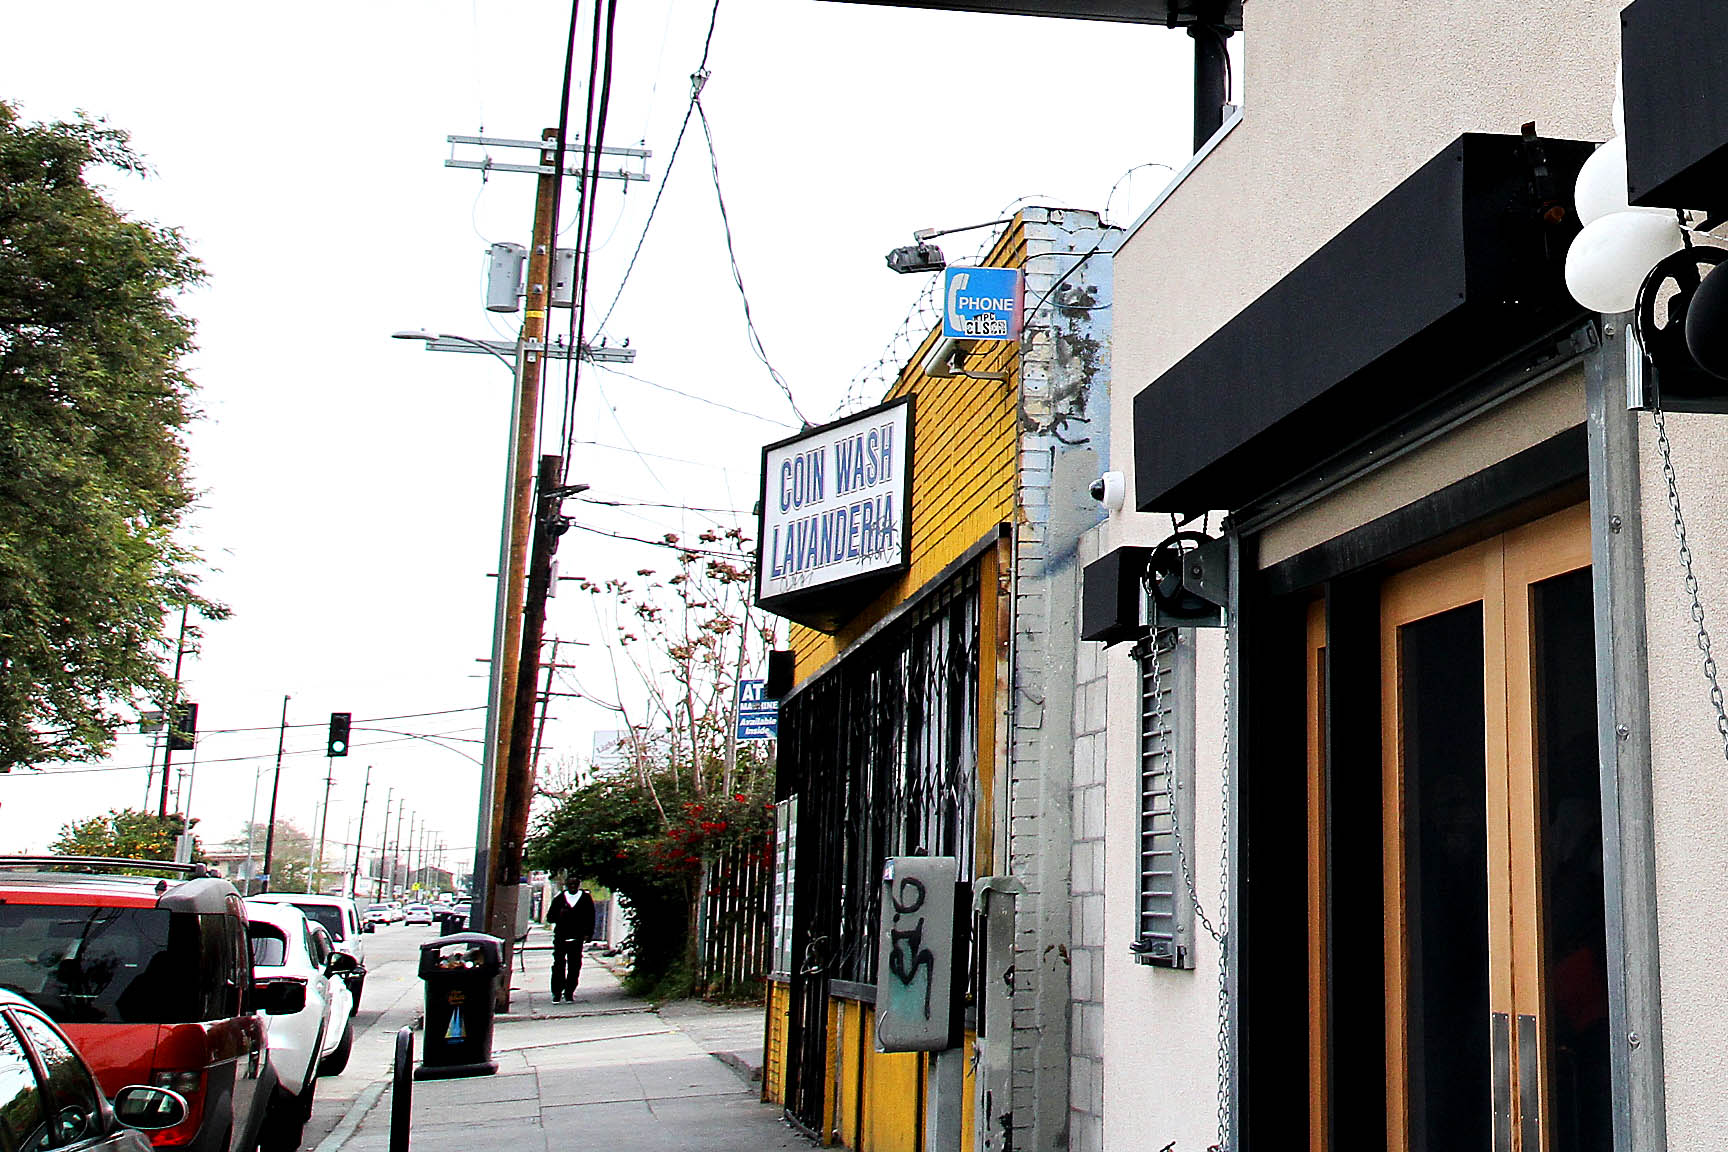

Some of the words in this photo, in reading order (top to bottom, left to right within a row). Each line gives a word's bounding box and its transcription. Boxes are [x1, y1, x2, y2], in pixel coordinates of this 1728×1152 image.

[959, 296, 1014, 311] PHONE
[779, 445, 826, 514] COIN
[834, 422, 895, 497] WASH
[770, 491, 894, 581] LAVANDERIA
[741, 683, 768, 701] AT
[740, 701, 779, 710] MAINE
[739, 717, 777, 726] Available
[745, 726, 770, 735] Inside
